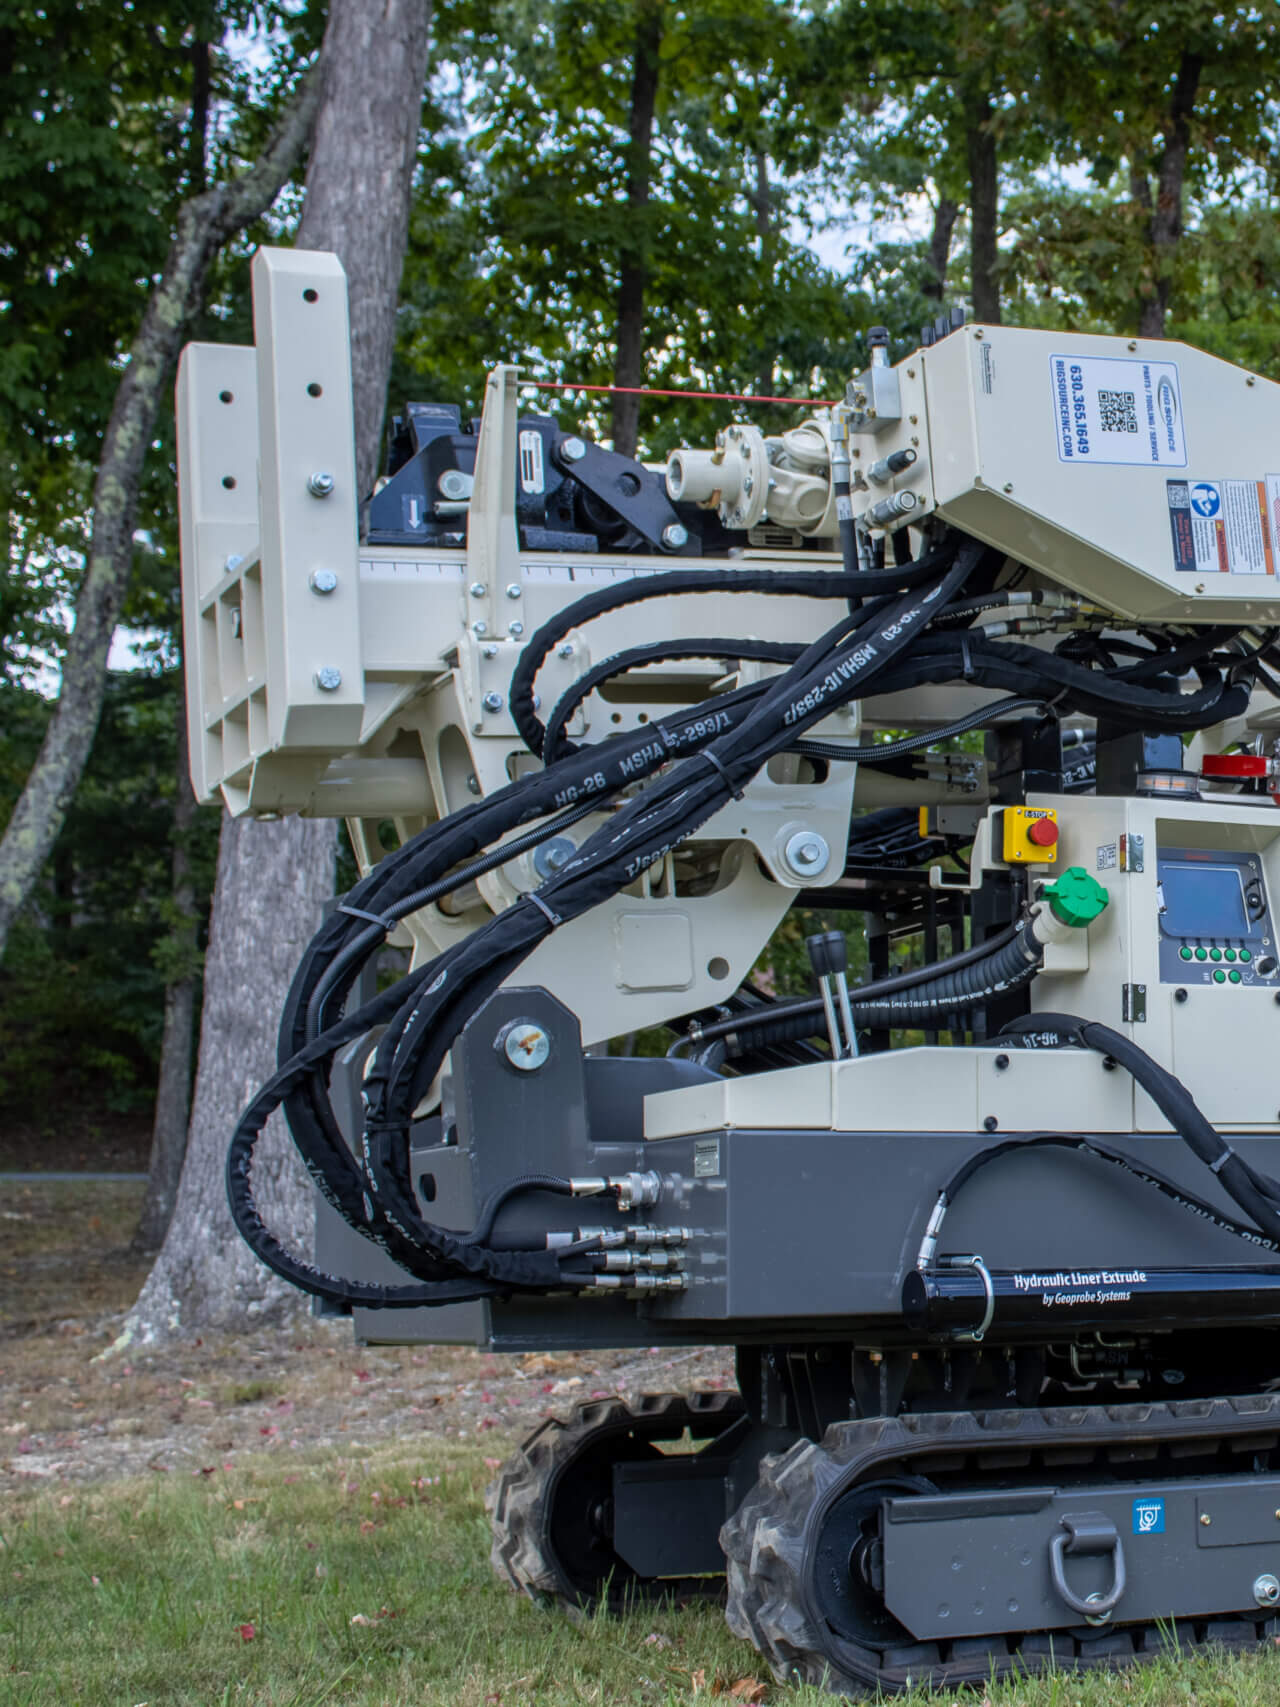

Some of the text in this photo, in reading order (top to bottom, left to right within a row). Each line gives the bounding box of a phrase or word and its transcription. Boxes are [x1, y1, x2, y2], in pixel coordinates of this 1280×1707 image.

[1143, 365, 1151, 388] PARTS
[1056, 360, 1073, 457] RIGSOURCEINC.COM
[1070, 365, 1089, 454] 630.365.1649
[1146, 395, 1155, 426] TOOLING
[1150, 431, 1159, 461] SERVICE
[1165, 406, 1176, 453] SOURCE
[837, 644, 878, 679] MSHA
[784, 673, 843, 725] IC-293/1
[555, 711, 733, 807] HG-26 MSHA C-293/1
[1014, 1270, 1147, 1291] Hydraulic Liner Extrude
[1042, 1290, 1131, 1307] by Geoprobe Systems
